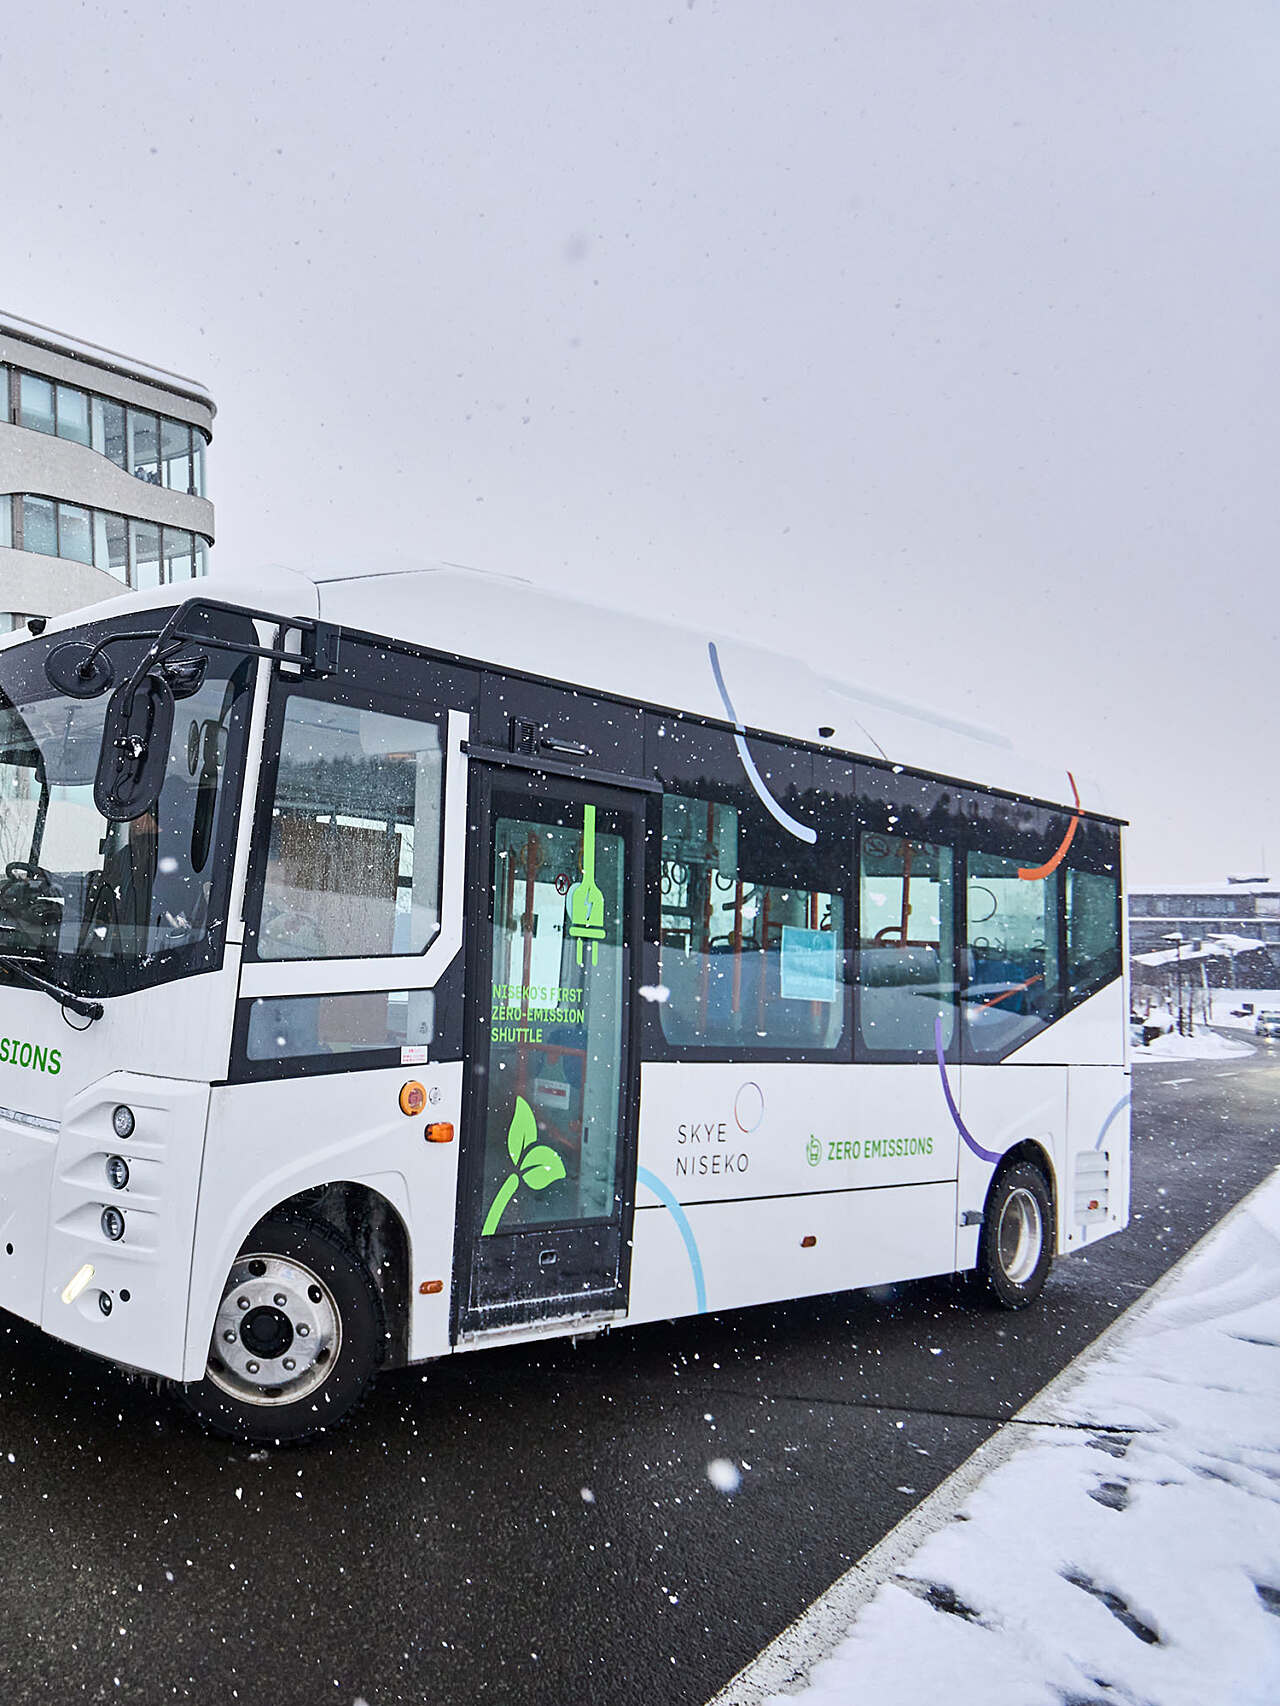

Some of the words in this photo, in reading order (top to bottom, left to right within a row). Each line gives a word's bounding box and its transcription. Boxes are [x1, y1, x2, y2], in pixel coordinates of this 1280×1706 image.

[492, 984, 548, 1000] NISEKO'S
[551, 987, 583, 1002] FIRST
[491, 1006, 585, 1023] ZERO-EMISSION
[491, 1027, 543, 1043] SHUTTLE
[678, 1123, 726, 1144] SKYE
[828, 1141, 861, 1160] ZERO
[864, 1137, 933, 1158] EMISSIONS
[676, 1153, 748, 1176] NISEKO
